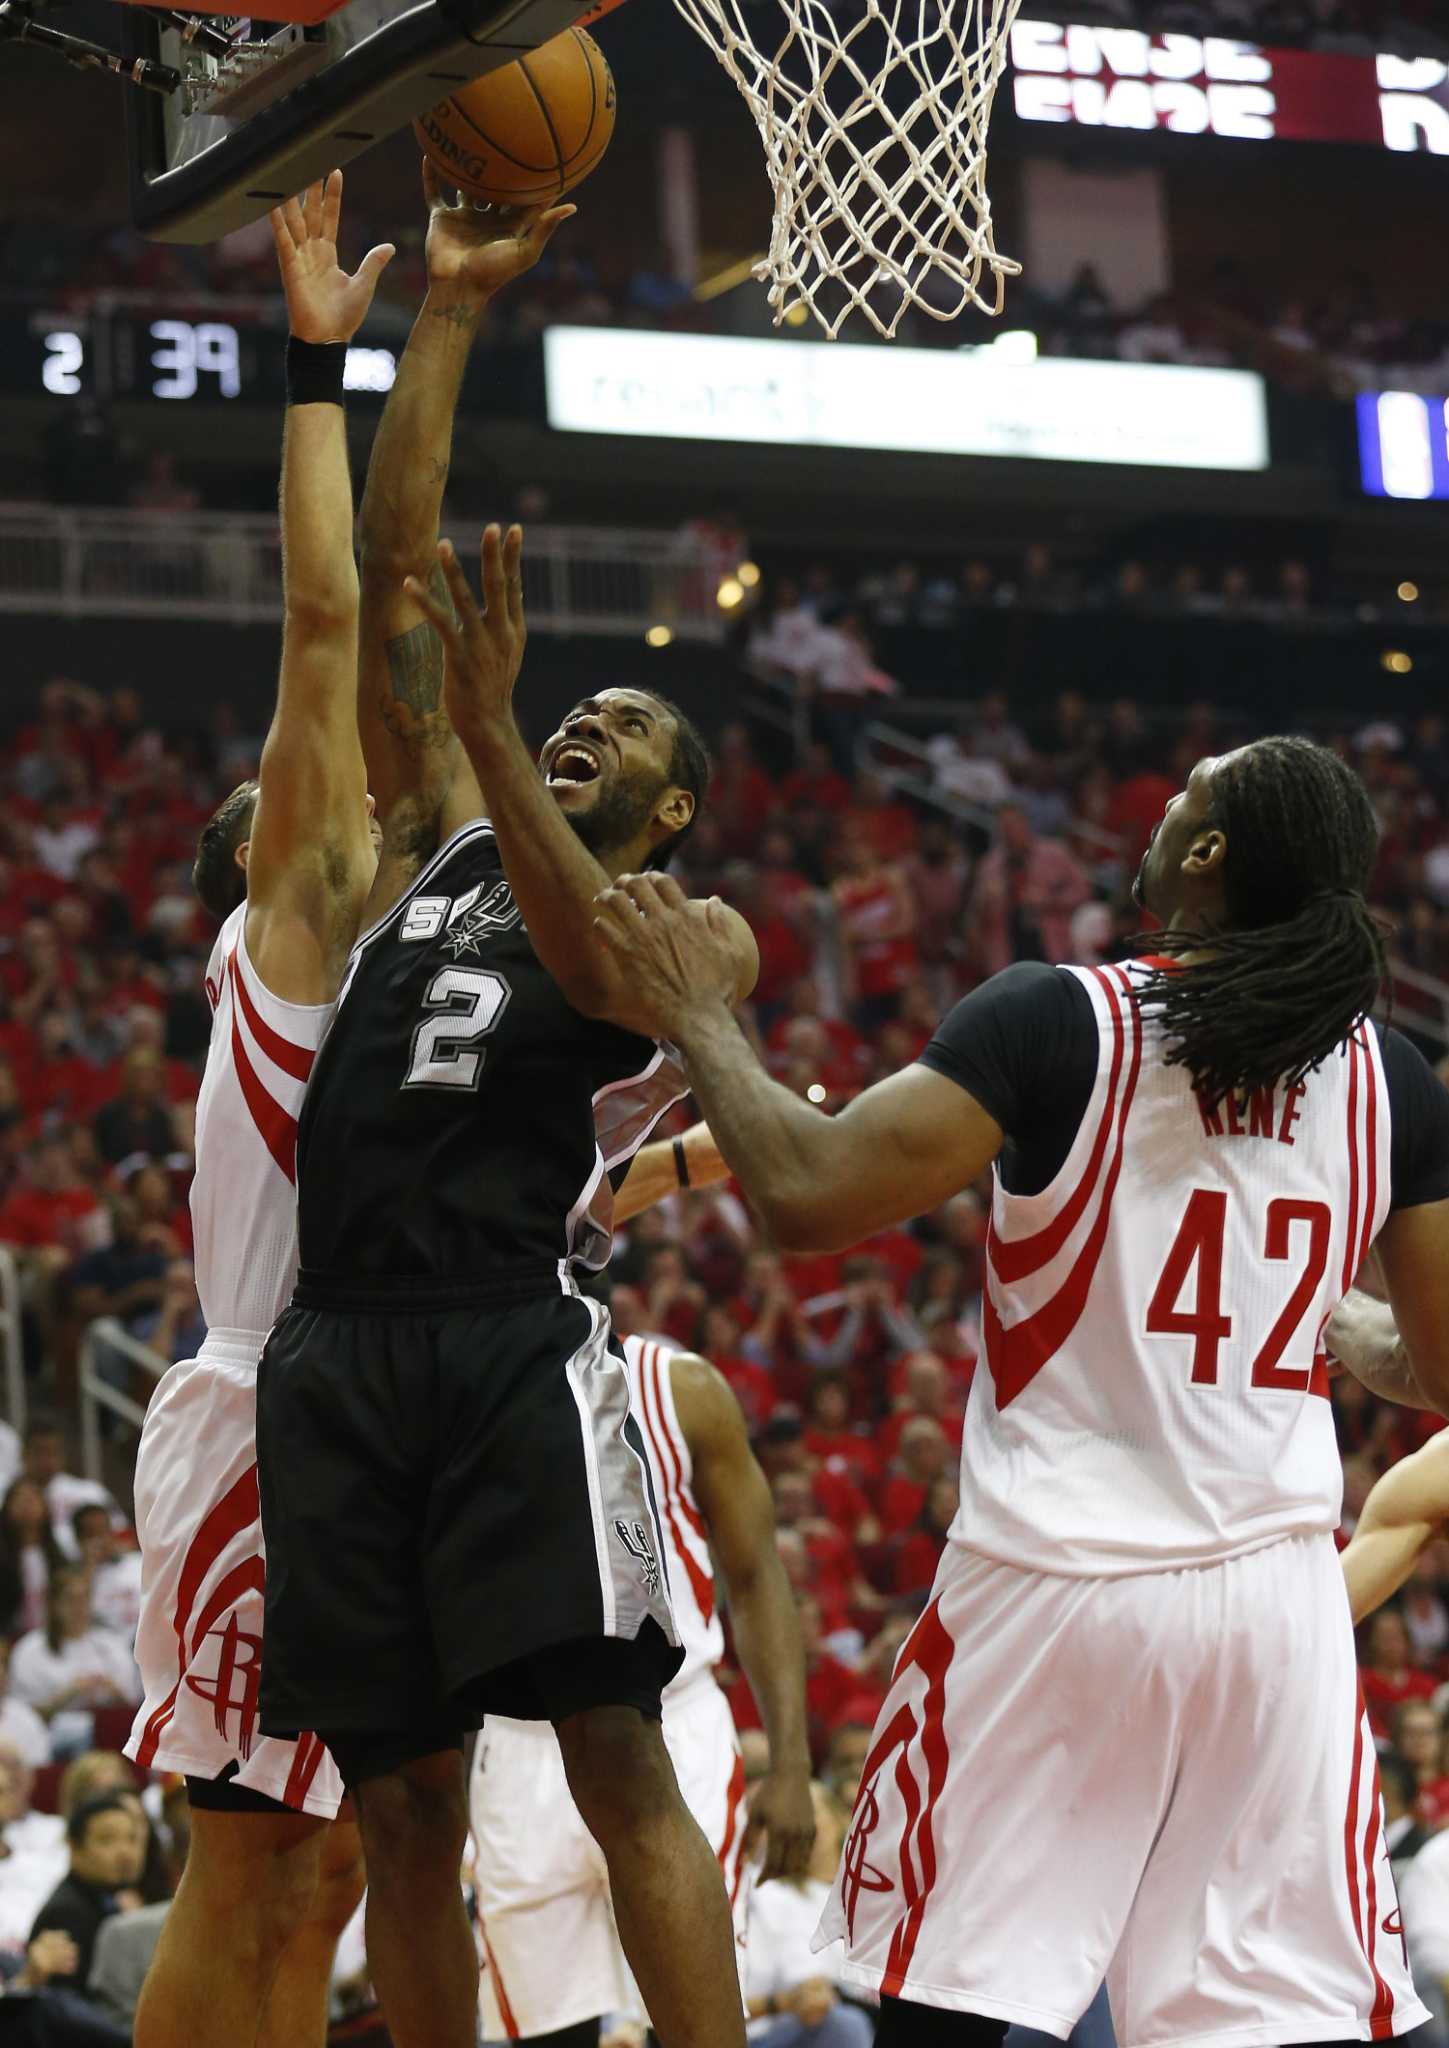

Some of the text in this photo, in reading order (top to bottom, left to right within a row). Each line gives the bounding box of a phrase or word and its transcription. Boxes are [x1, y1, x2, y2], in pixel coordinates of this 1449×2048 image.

[42, 332, 83, 394] 2
[401, 965, 512, 1091] 2
[1145, 1187, 1332, 1392] 42
